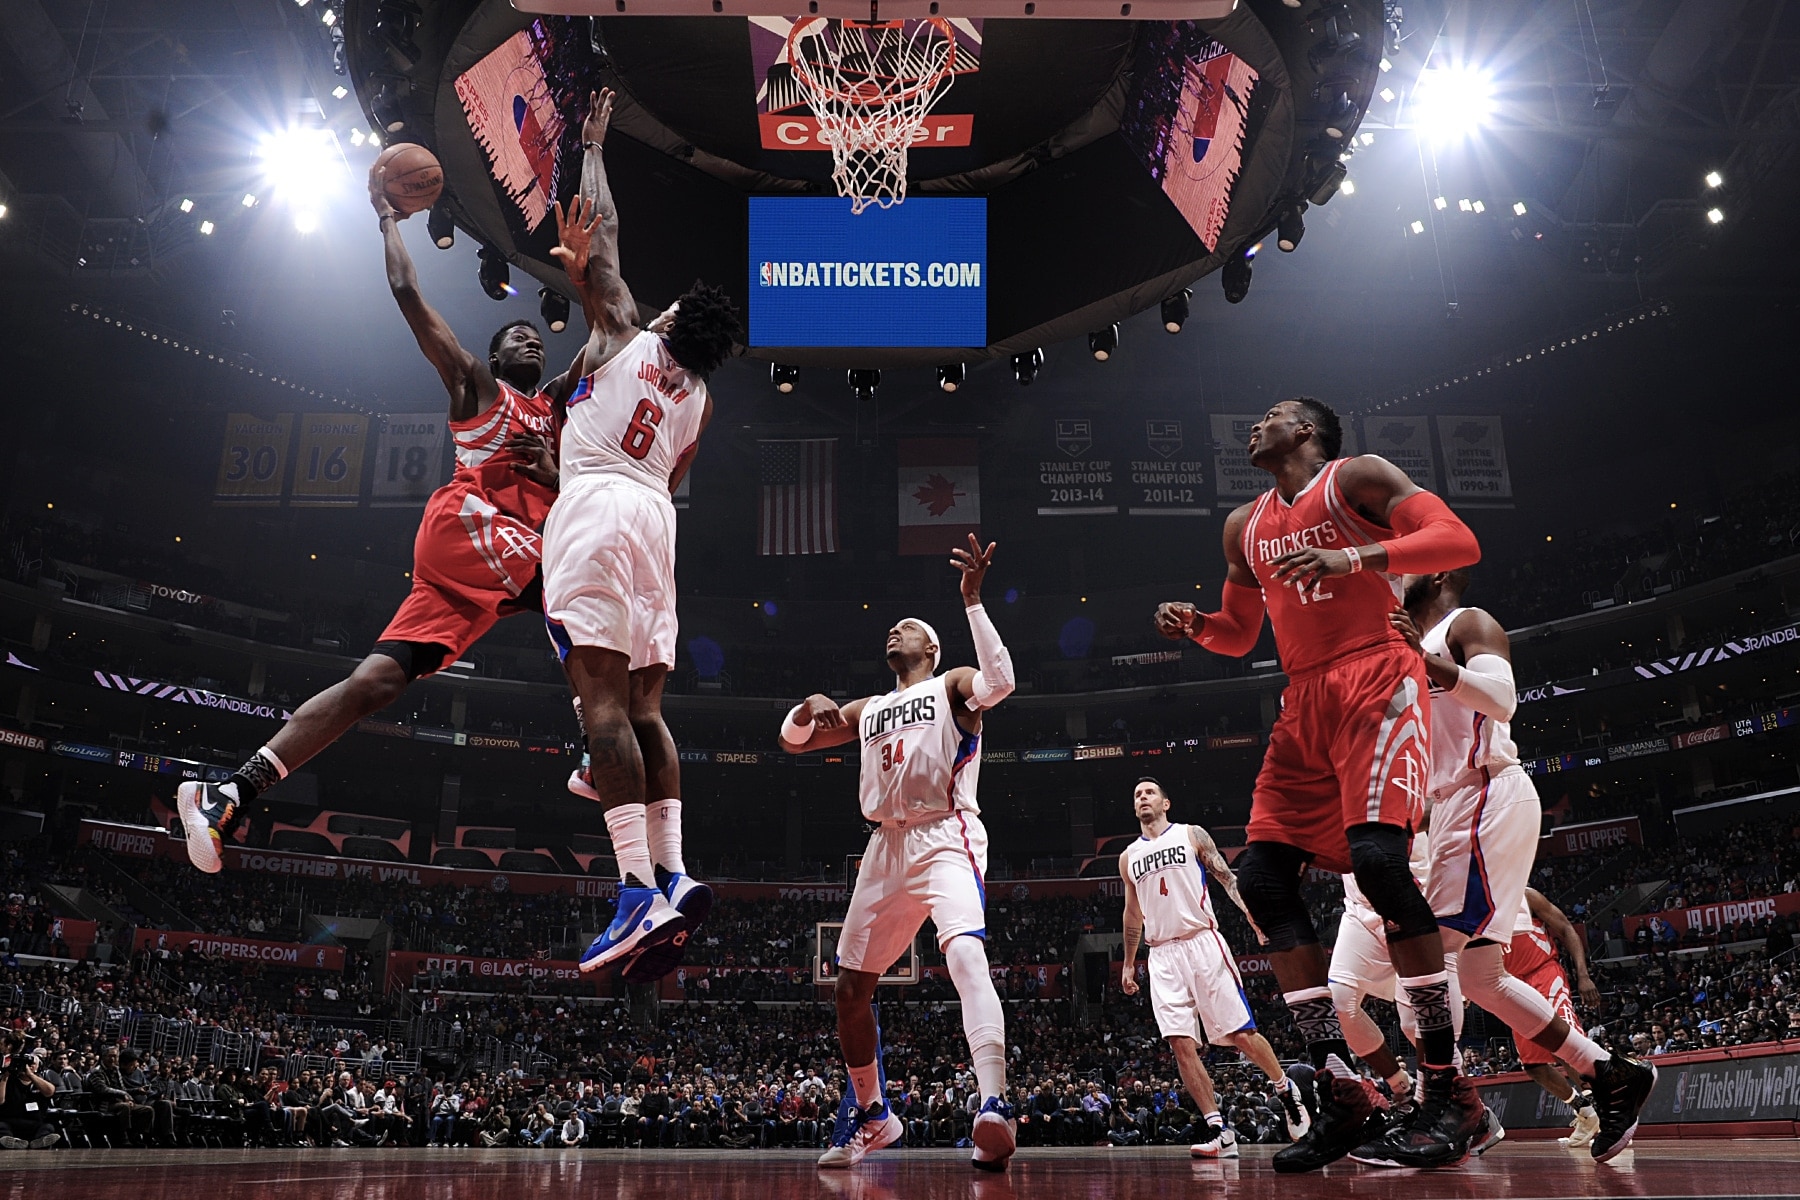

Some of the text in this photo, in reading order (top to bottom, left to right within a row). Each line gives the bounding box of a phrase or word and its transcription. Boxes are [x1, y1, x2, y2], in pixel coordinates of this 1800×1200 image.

[772, 262, 980, 287] NBATICKETS.COM
[637, 360, 690, 405] JORDAN
[391, 423, 435, 435] TAYLOR
[620, 397, 663, 460] 6
[226, 445, 279, 482] 30
[307, 446, 348, 482] 16
[386, 446, 427, 482] 18
[1040, 461, 1112, 472] STANLEY CUP
[1131, 461, 1202, 471] STANLEY CUP
[1040, 472, 1113, 484] CHAMPIONS
[1132, 473, 1204, 484] CHAMPIONS
[1452, 469, 1503, 477] CHAMPIONS
[1460, 481, 1499, 491] 1990-91
[1051, 488, 1104, 502] 2013-14
[1144, 489, 1195, 502] 2011-12
[1257, 520, 1338, 562] ROCKETS
[151, 584, 202, 604] TOYOTA
[200, 693, 276, 719] BRANDBLACK
[864, 695, 936, 742] CLIPPERS
[1735, 718, 1751, 729] UTA
[1761, 712, 1777, 723] 119
[1737, 721, 1778, 737] CHA 124
[484, 738, 520, 748] TOYOTA
[1607, 746, 1626, 755] SAN
[1631, 739, 1669, 751] MANUEL
[120, 751, 135, 760] PHI
[716, 752, 758, 764] STAPLES
[882, 738, 905, 772] 34
[1075, 746, 1124, 759] TOSHIBA
[118, 759, 130, 767] NY
[1522, 761, 1537, 769] PHI
[1546, 757, 1561, 765] 113
[1547, 765, 1561, 773] 119
[1585, 758, 1601, 766] NBA
[182, 770, 198, 779] NBA
[104, 831, 155, 855] CLIPPERS
[240, 853, 338, 877] TOGETHER
[1132, 845, 1186, 880] CLIPPERS
[1160, 876, 1168, 897] 4
